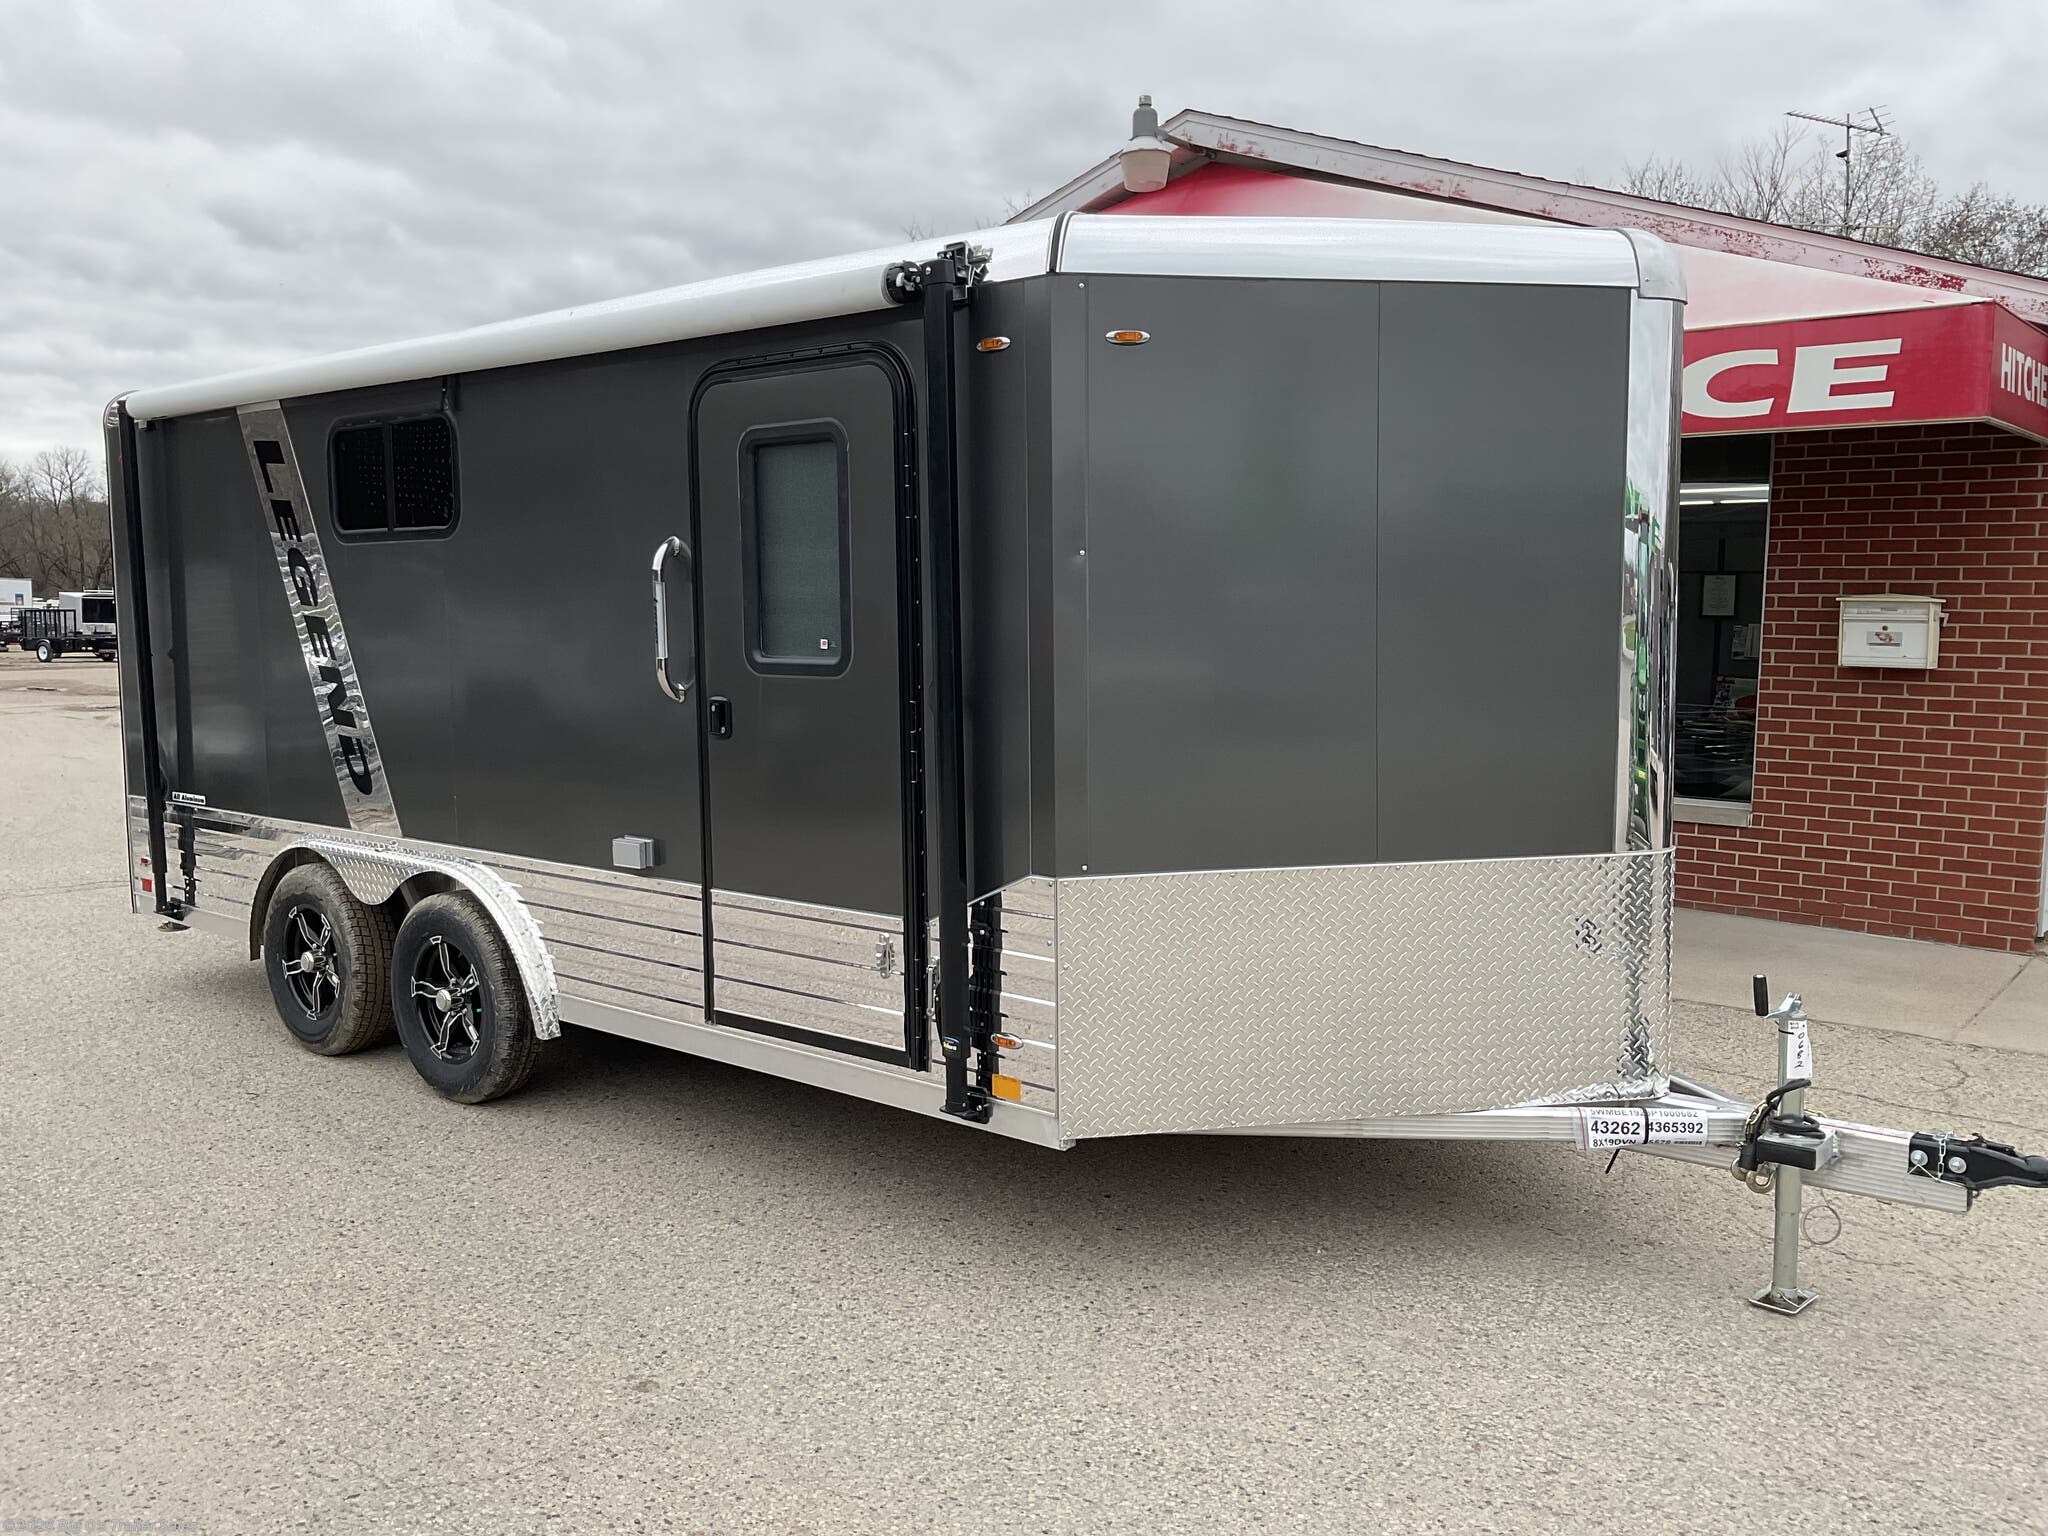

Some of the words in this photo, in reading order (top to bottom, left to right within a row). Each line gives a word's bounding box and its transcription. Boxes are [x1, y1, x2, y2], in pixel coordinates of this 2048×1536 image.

[253, 440, 373, 795] LEGEND
[1591, 1120, 1640, 1135] 43262
[1648, 1121, 1703, 1134] 4365392
